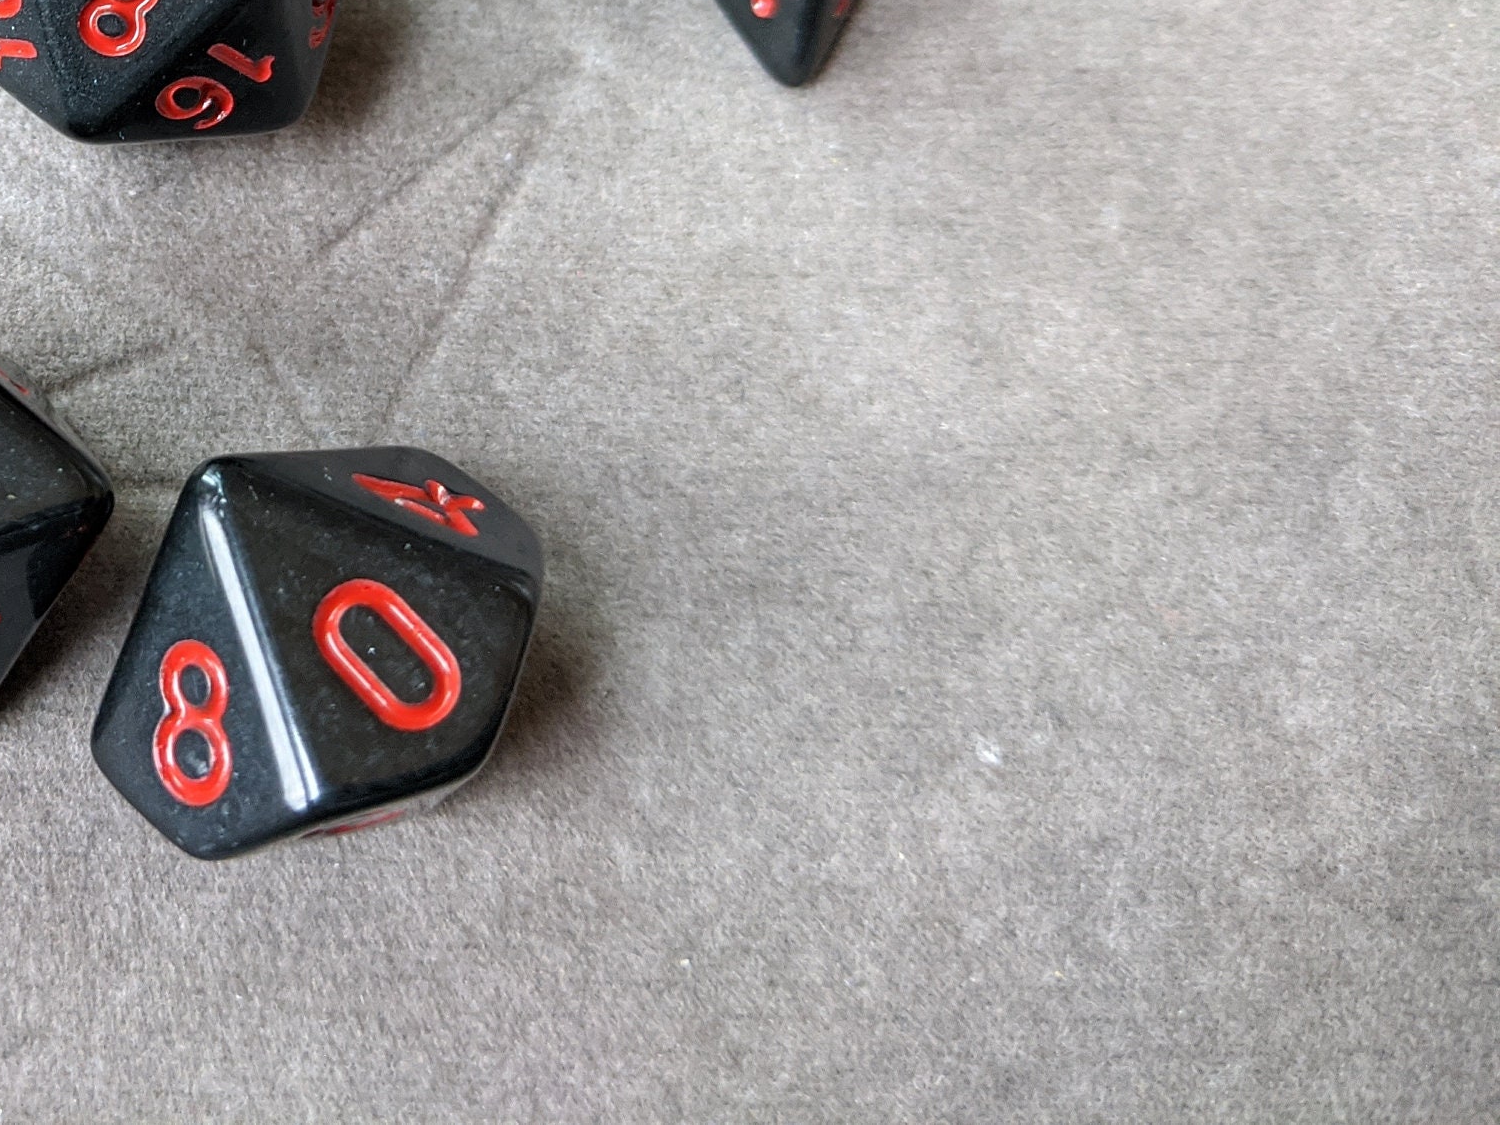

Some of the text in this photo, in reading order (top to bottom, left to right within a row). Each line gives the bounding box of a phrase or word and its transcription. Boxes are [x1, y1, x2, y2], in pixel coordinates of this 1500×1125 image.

[154, 42, 276, 131] 16
[351, 473, 487, 539] 4
[311, 577, 463, 734] 0
[152, 637, 234, 809] 8
